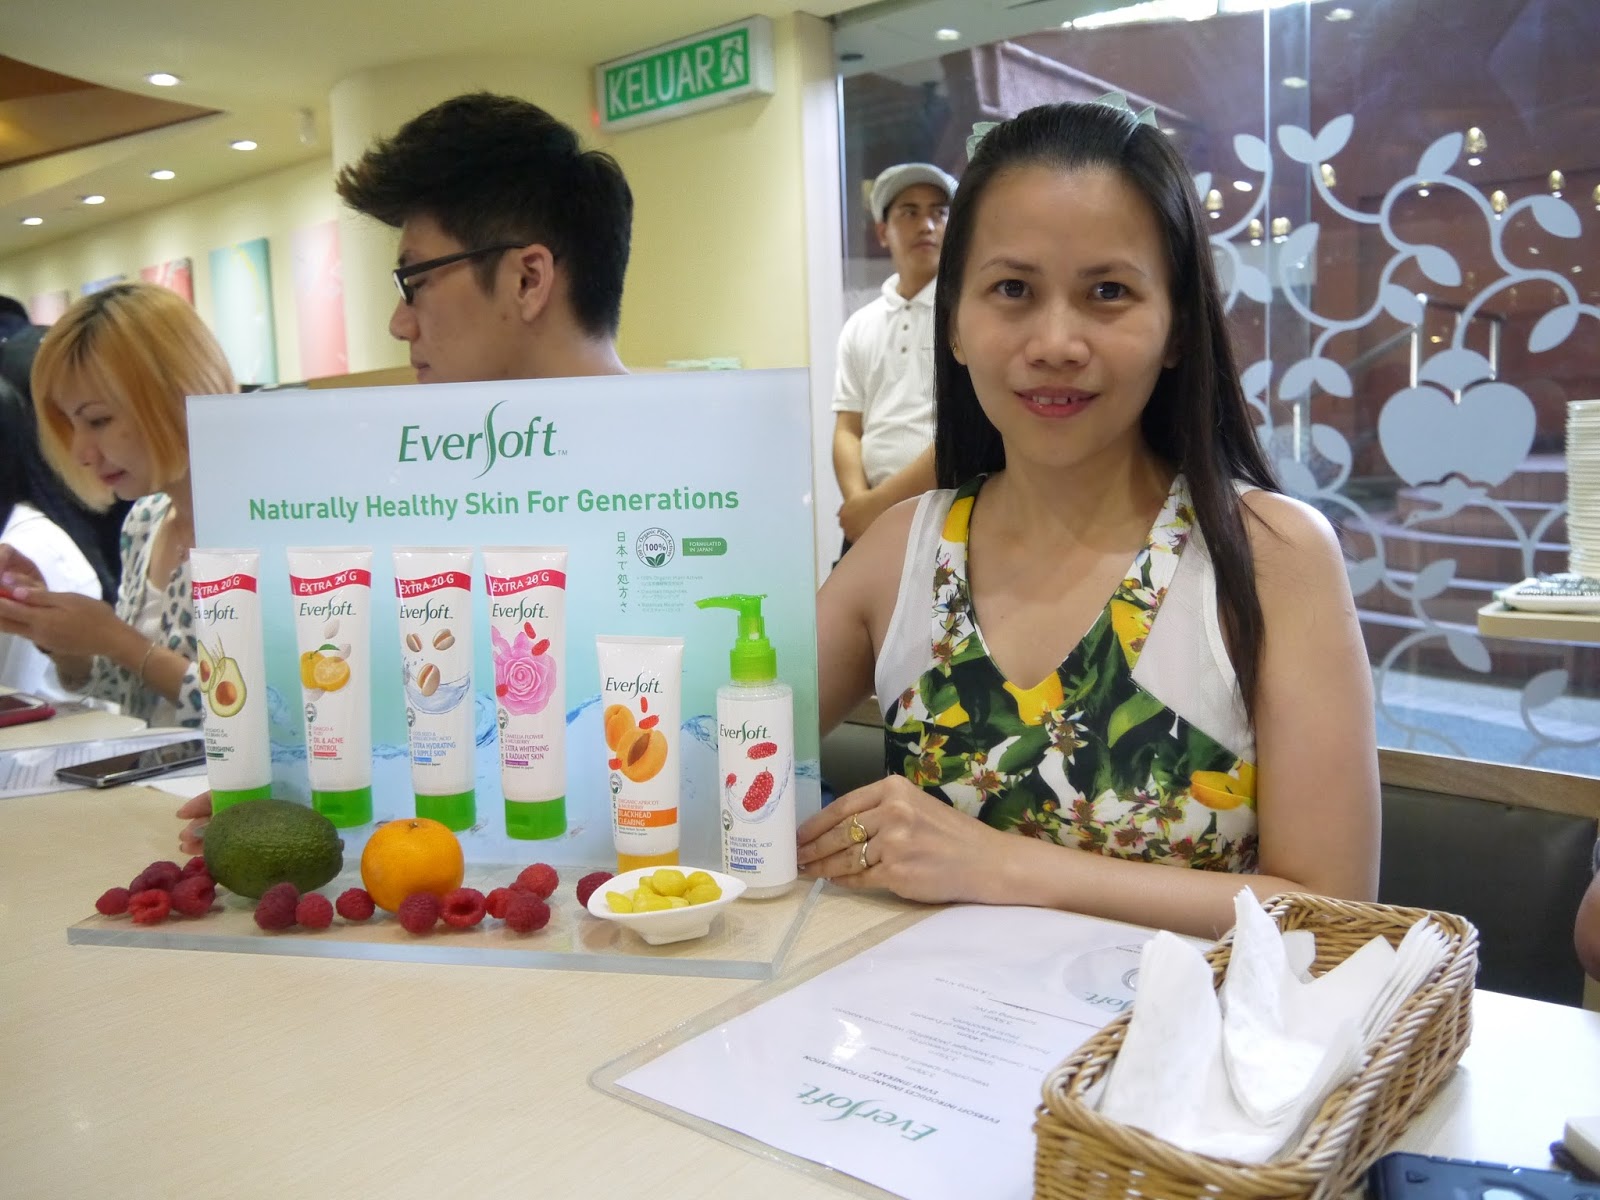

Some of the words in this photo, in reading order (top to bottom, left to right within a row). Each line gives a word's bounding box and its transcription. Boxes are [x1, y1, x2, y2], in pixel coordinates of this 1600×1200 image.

[607, 44, 715, 116] KELUAR
[249, 496, 358, 523] Naturally
[366, 494, 458, 521] Healthy
[465, 491, 519, 514] Skin
[527, 490, 569, 514] For
[577, 486, 739, 512] Generations
[645, 543, 666, 551] 100%
[193, 584, 219, 595] EXTRA
[221, 579, 231, 590] 20
[233, 576, 240, 586] G
[300, 580, 332, 592] EXTRA
[335, 574, 346, 585] 20
[349, 571, 357, 581] G
[400, 582, 429, 594] EXTRA
[432, 576, 443, 588] 20
[446, 573, 454, 583] G
[493, 580, 524, 592] EXTRA
[527, 574, 539, 585] 20
[541, 572, 550, 582] G
[509, 752, 530, 760] RADIANT
[619, 810, 651, 818] BLACKHEAD
[619, 818, 645, 826] CLEARING
[730, 848, 757, 856] WHITENING
[734, 856, 764, 865] HYDRATING
[857, 1074, 905, 1091] ENHANCED
[872, 1071, 913, 1086] ITINERARY
[913, 1085, 939, 1095] EVENT
[903, 1090, 959, 1110] INTRODUCES
[957, 1108, 1001, 1124] EVERSOFT
